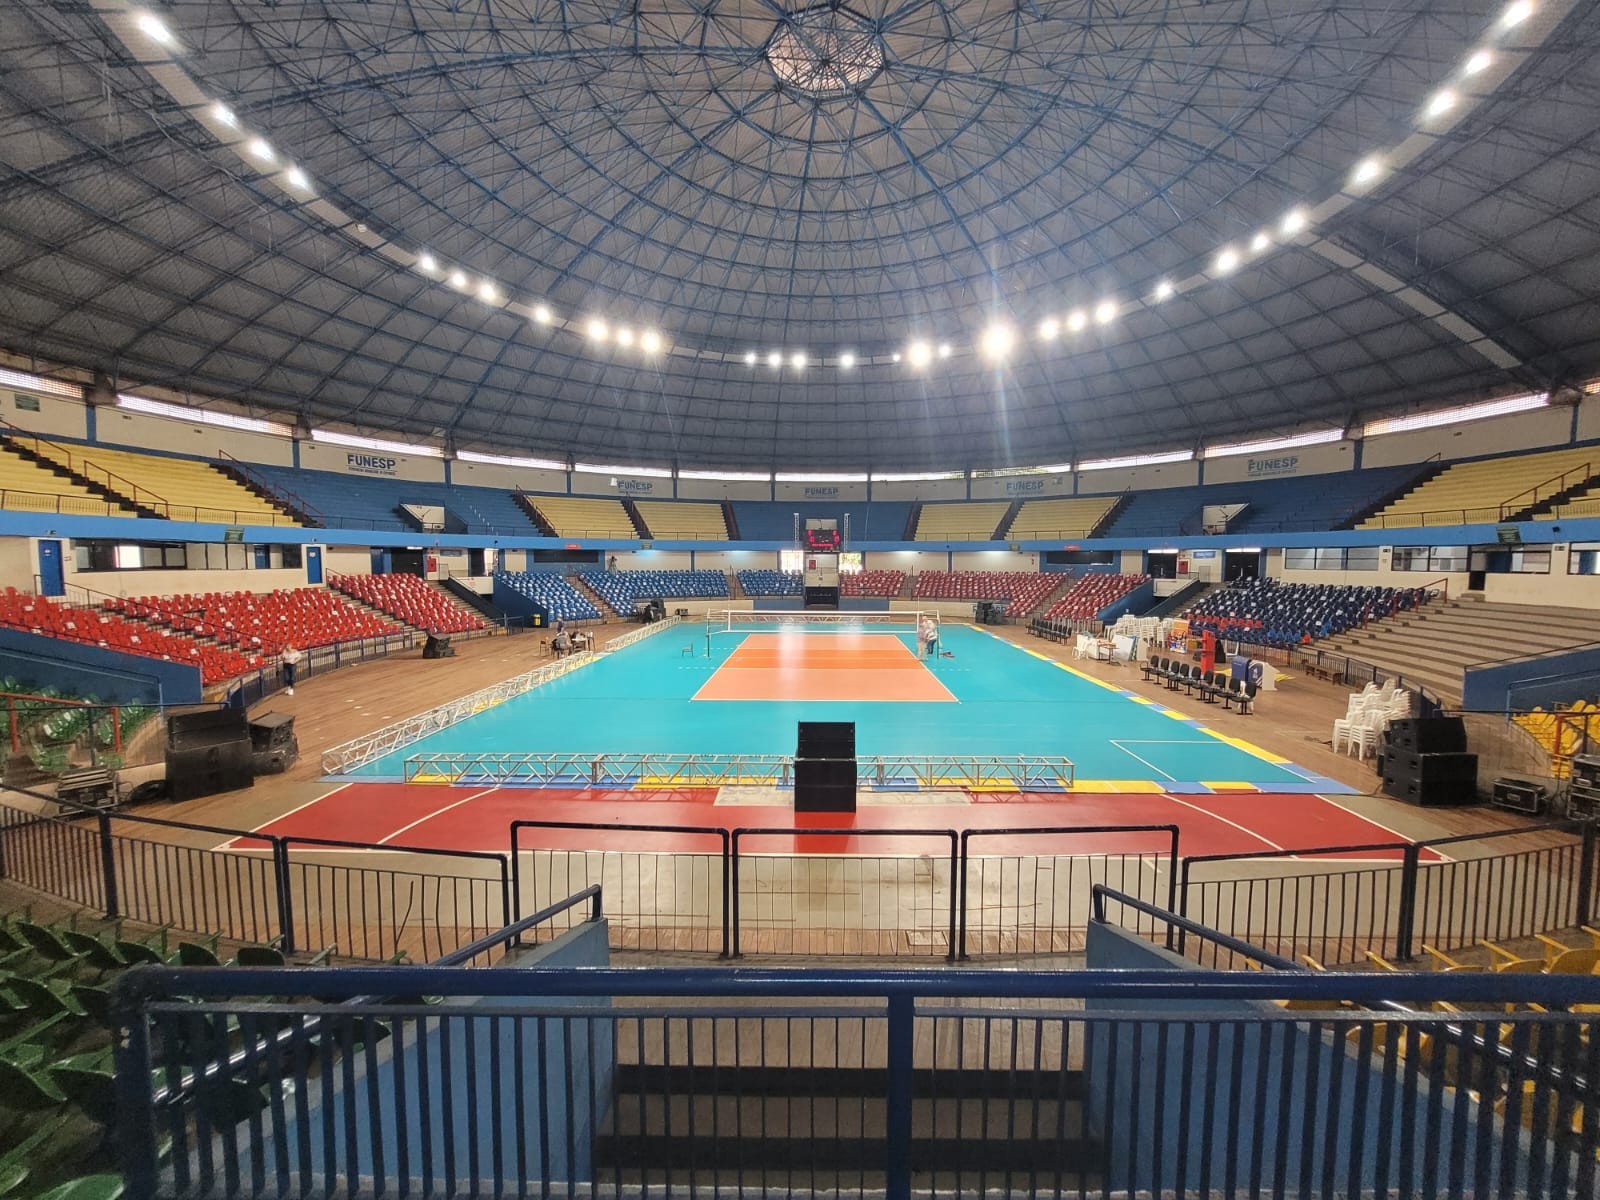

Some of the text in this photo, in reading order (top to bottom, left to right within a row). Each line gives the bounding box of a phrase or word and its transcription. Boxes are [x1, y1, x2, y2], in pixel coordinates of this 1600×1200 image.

[347, 454, 396, 469] FUNESP
[1248, 456, 1298, 471] FUNESP
[618, 480, 653, 489] FUNESP
